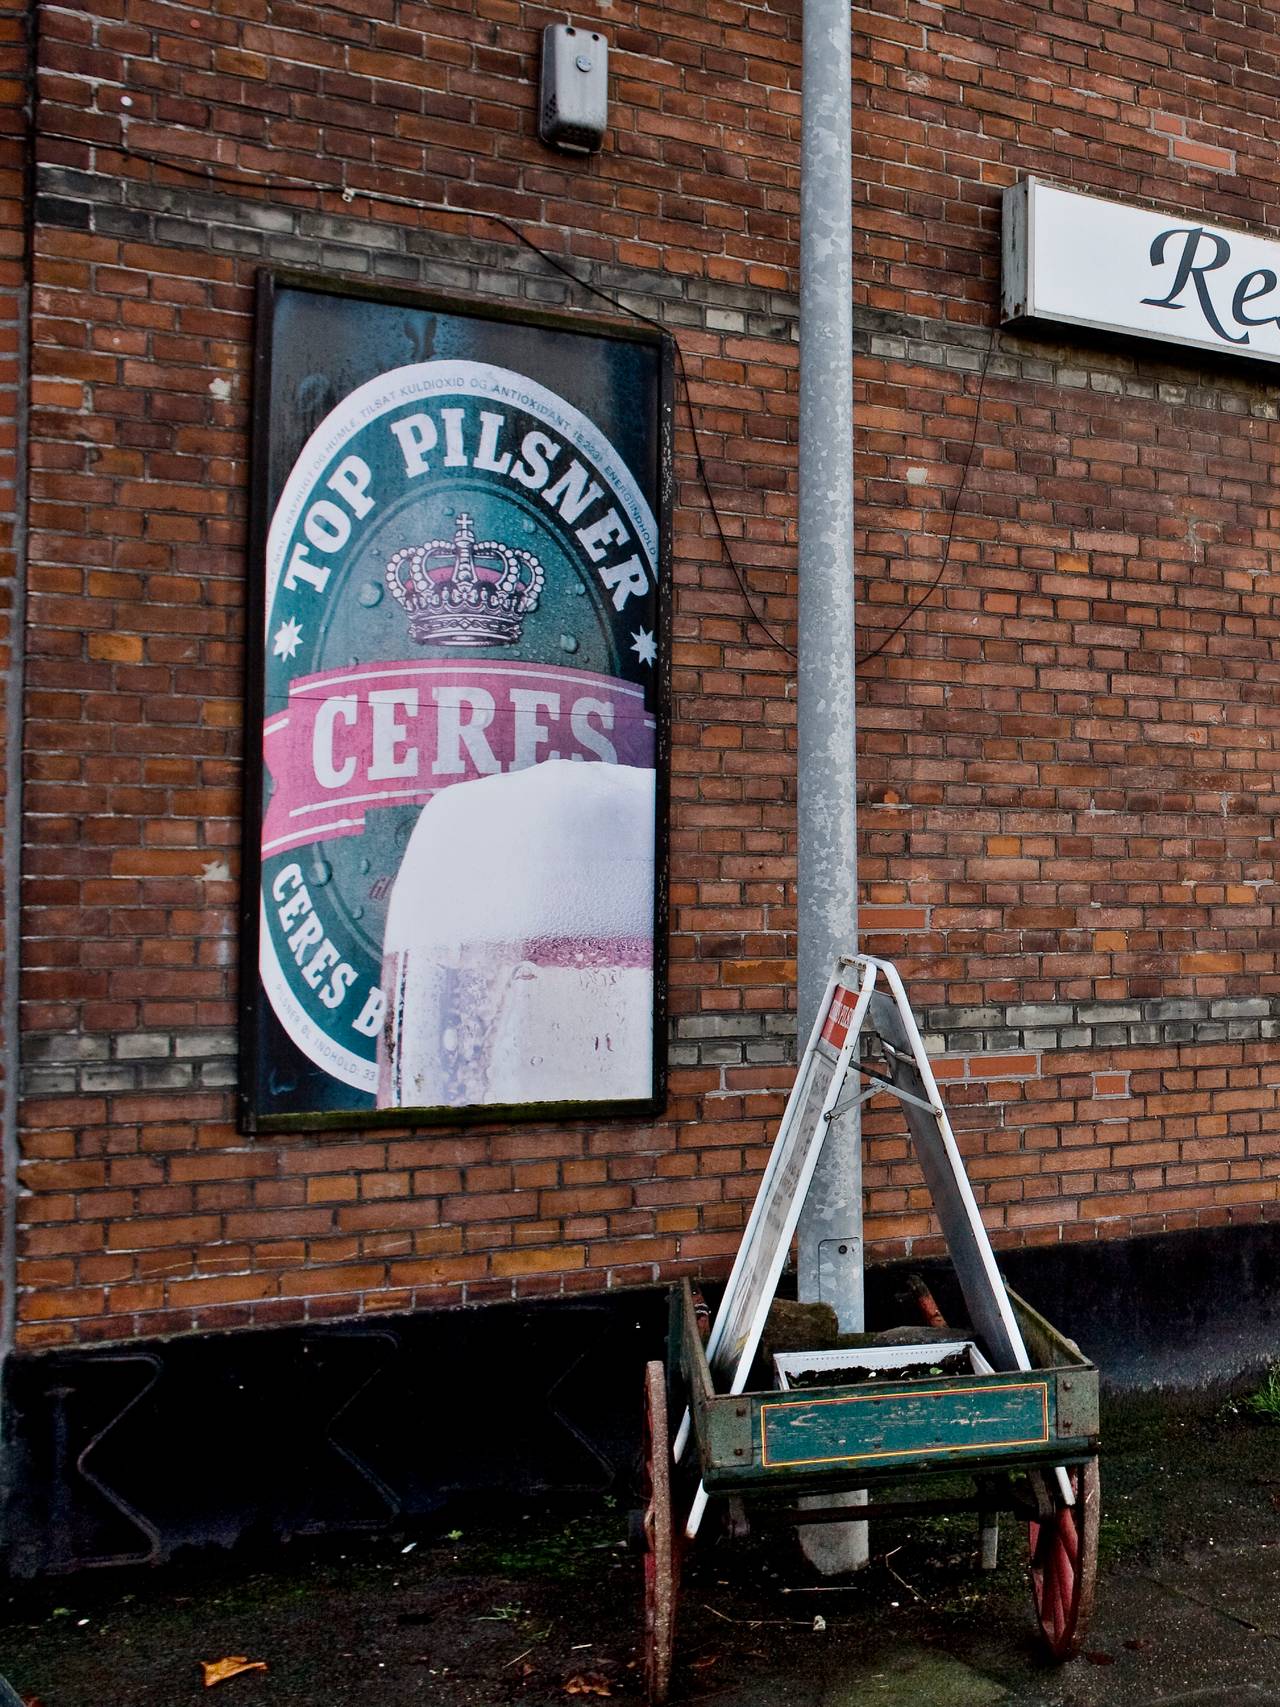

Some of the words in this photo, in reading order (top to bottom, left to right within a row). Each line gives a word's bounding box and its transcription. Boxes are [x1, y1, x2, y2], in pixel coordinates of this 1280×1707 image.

[400, 377, 465, 397] KULDIOXID
[470, 378, 488, 389] OG
[492, 384, 571, 431] ANTIOXIDANT
[284, 455, 373, 593] TOP
[391, 408, 650, 611] PILSNER
[312, 686, 618, 788] CERES
[273, 862, 358, 1009] CERES
